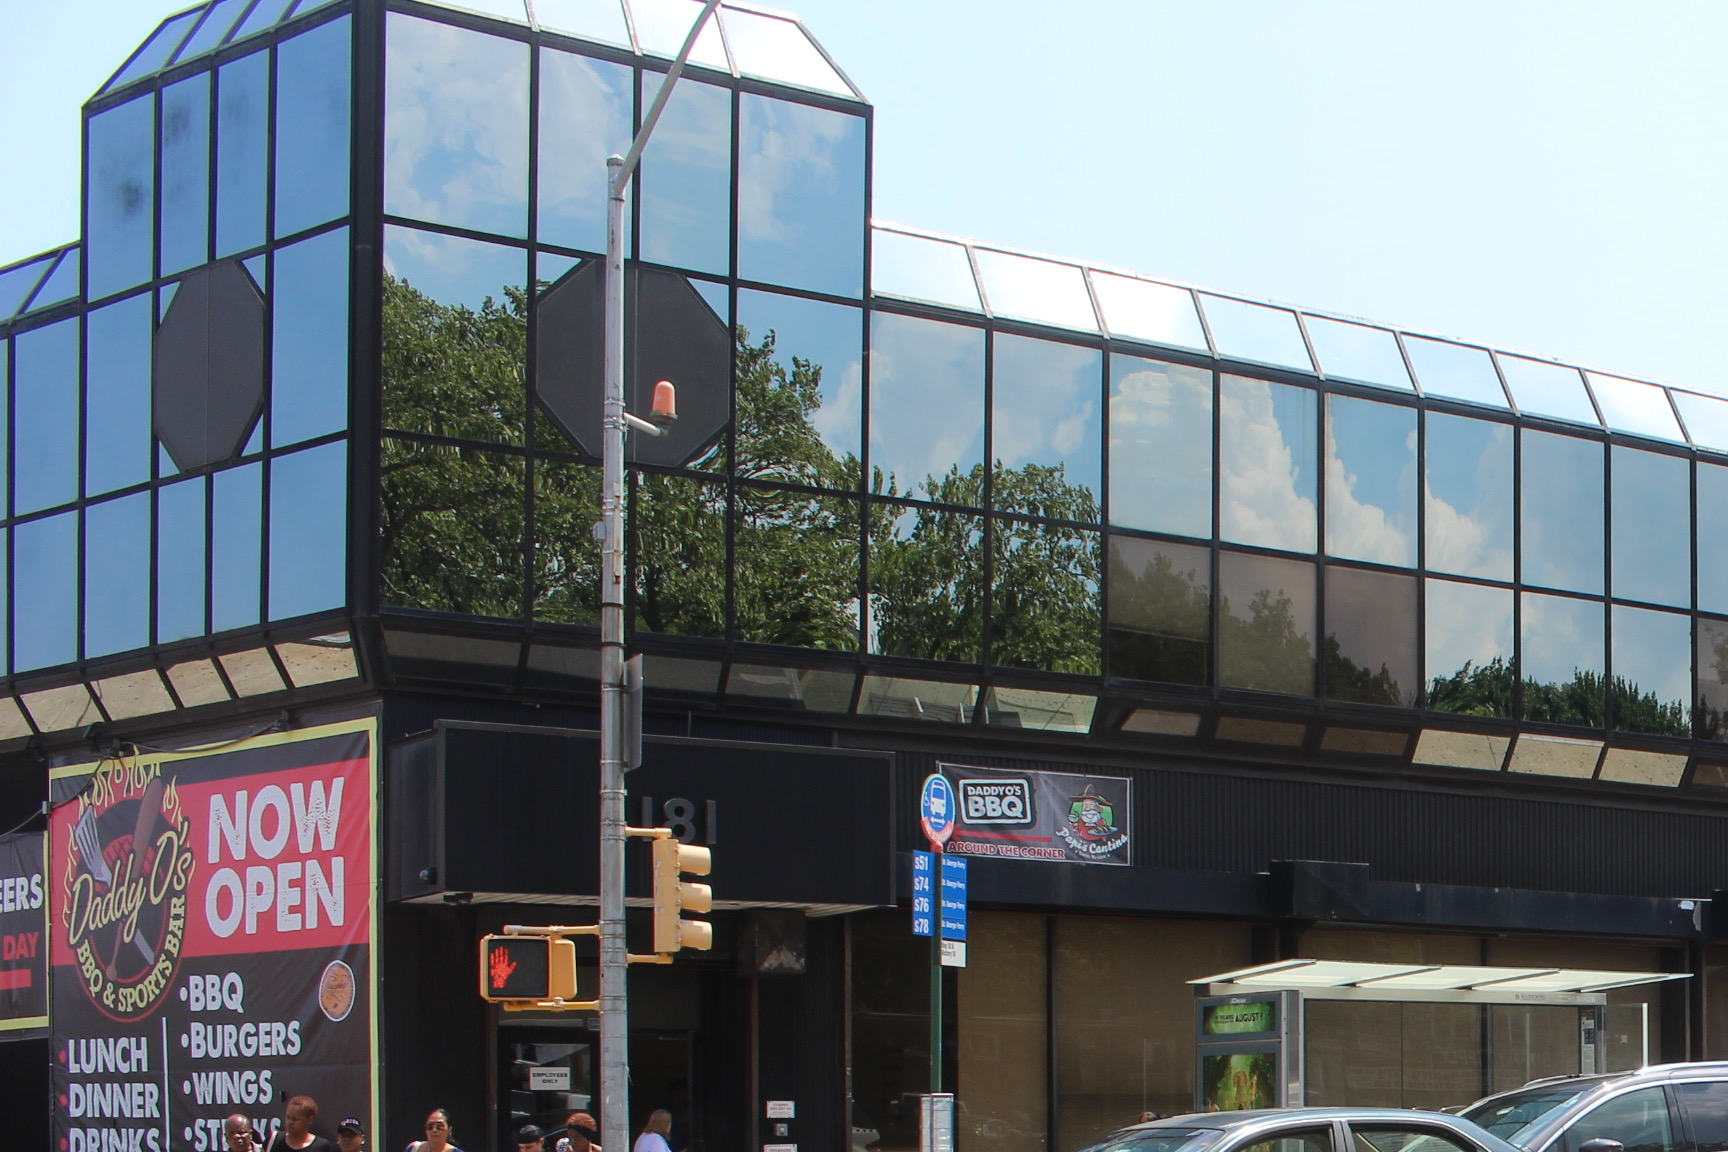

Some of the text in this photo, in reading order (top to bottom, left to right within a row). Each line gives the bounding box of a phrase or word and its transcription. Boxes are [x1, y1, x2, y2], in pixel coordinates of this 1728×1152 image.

[208, 777, 345, 864] NOW
[967, 796, 1024, 818] BBQ
[947, 841, 997, 855] AROUND
[997, 846, 1019, 856] THE
[1021, 847, 1066, 860] CORNER
[1056, 826, 1129, 854] Papi's Cantina
[914, 855, 929, 871] S51
[0, 873, 44, 914] ERS
[69, 853, 146, 944] Daddy
[205, 856, 345, 938] OPEN
[914, 877, 929, 892] S74
[914, 898, 929, 913] S76
[914, 919, 929, 934] S78
[3, 932, 39, 960] DAY
[77, 895, 185, 1012] BBQ & SPORTS BAR
[190, 972, 244, 1013] BBQ
[69, 1037, 148, 1074] LUNCH
[191, 1020, 302, 1059] BURGERS
[69, 1083, 160, 1118] DINNER
[192, 1070, 273, 1105] WINGS
